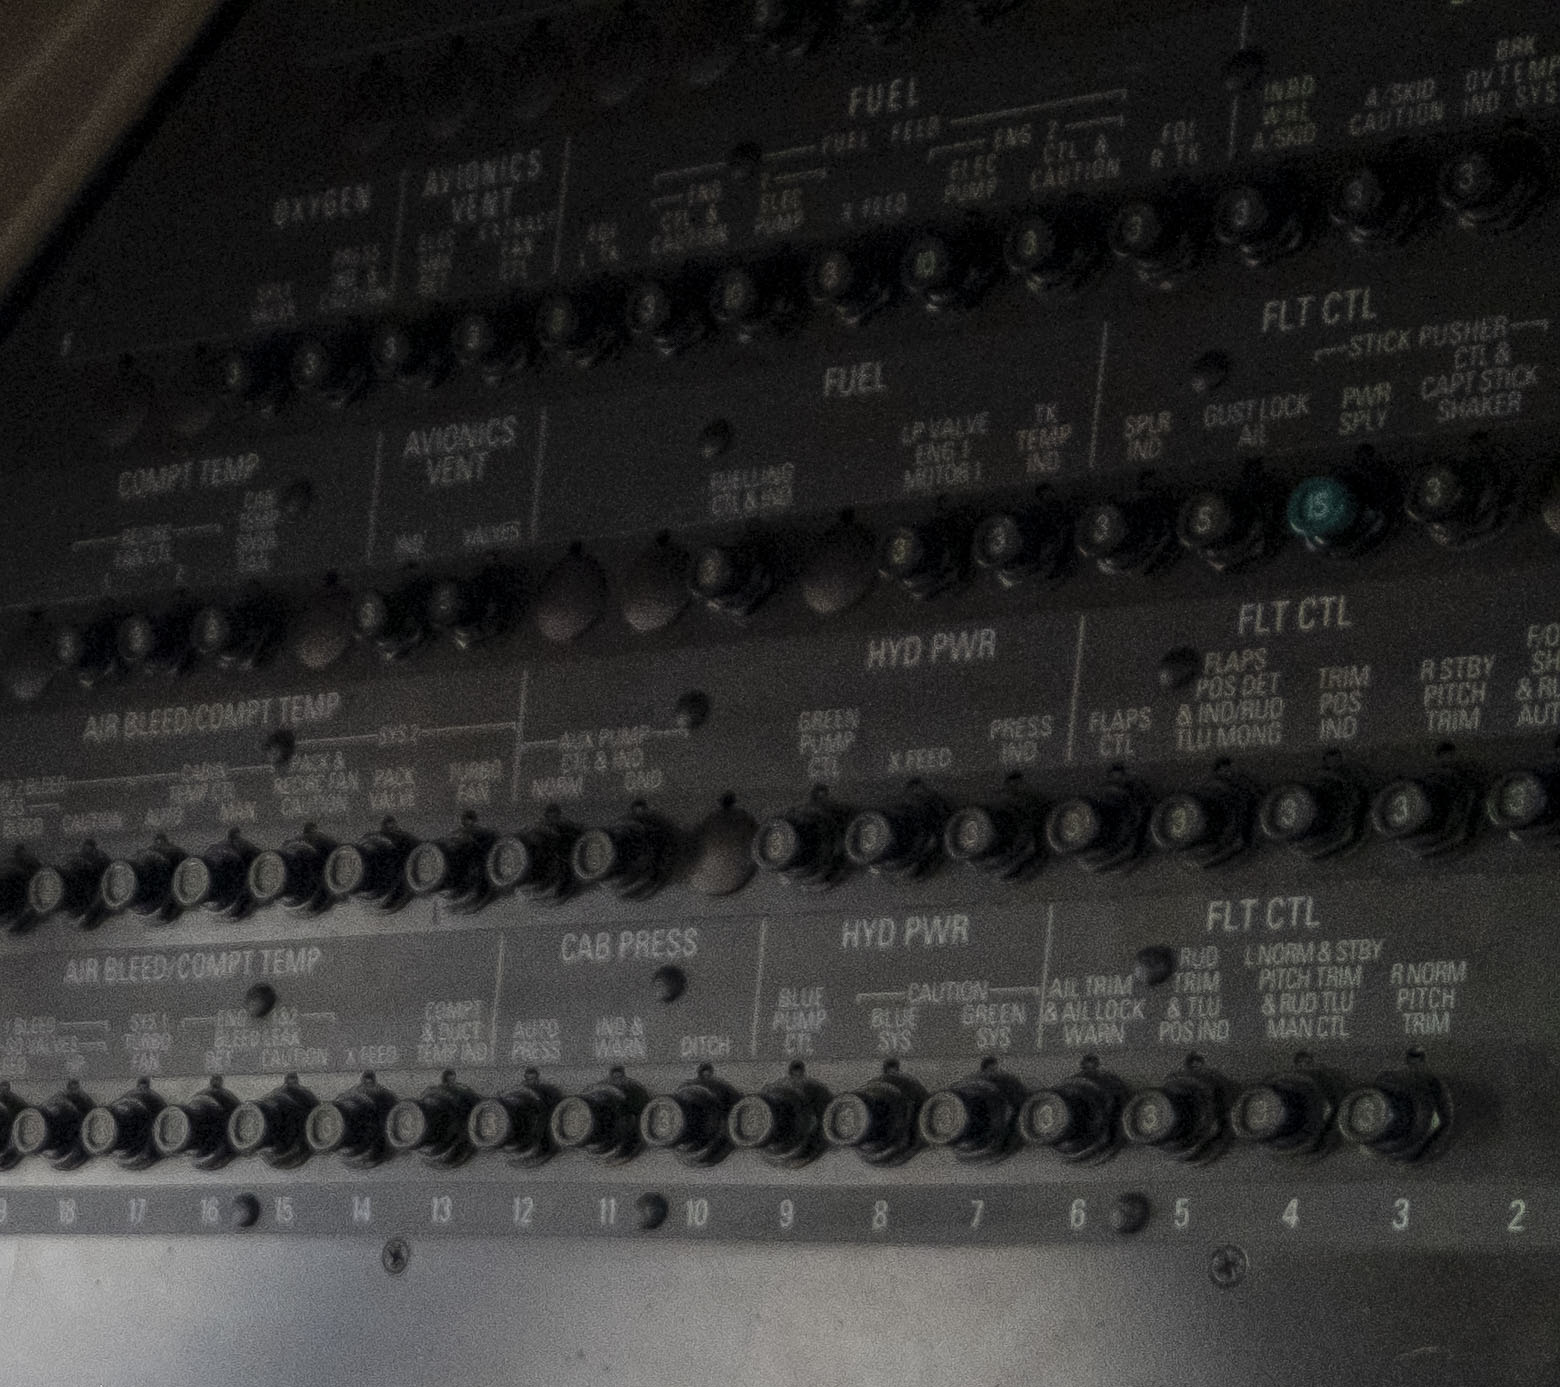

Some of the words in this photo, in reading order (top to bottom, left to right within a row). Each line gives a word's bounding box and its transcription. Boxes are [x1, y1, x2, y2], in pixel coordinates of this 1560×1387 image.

[848, 77, 919, 116] FUEL
[422, 149, 543, 197] AVIONICS
[1262, 295, 1315, 333] FLT
[1322, 287, 1377, 325] CTL
[823, 360, 887, 398] FUEL
[404, 415, 517, 456] AVIONICS
[119, 462, 191, 499] COMPT
[200, 453, 260, 488] TEMP
[427, 453, 488, 486] VENT
[1238, 600, 1290, 636] FLT
[1298, 595, 1352, 630] CTL
[866, 635, 921, 670] HYD
[930, 627, 997, 663] PWR
[1320, 665, 1372, 688] TRIM
[82, 712, 118, 742] AIR
[280, 692, 340, 725] TEMP
[1089, 706, 1152, 733] FLAPS
[1320, 690, 1362, 714] POS
[841, 917, 896, 948] HYD
[904, 914, 970, 944] PWR
[1207, 899, 1258, 932] FLT
[1267, 896, 1320, 930] CTL
[561, 933, 611, 964] CAB
[620, 927, 699, 959] PRESS
[63, 957, 97, 985] AIR
[259, 945, 320, 978] TEMP
[1396, 988, 1456, 1010] PITCH
[1403, 1012, 1451, 1035] TRIM
[129, 1198, 147, 1224] 17
[200, 1198, 219, 1223] 16
[274, 1198, 294, 1225] 15
[352, 1197, 372, 1222] 14
[432, 1196, 454, 1224] 13
[512, 1195, 535, 1226] 12
[598, 1198, 617, 1226] 11
[686, 1199, 709, 1228] 10
[778, 1199, 795, 1228] 9
[872, 1200, 889, 1231] 8
[971, 1200, 985, 1229] 7
[1069, 1198, 1086, 1228] 6
[1174, 1197, 1190, 1228] 5
[1282, 1197, 1299, 1228] 4
[1391, 1198, 1411, 1231] 3
[1507, 1198, 1526, 1232] 2
